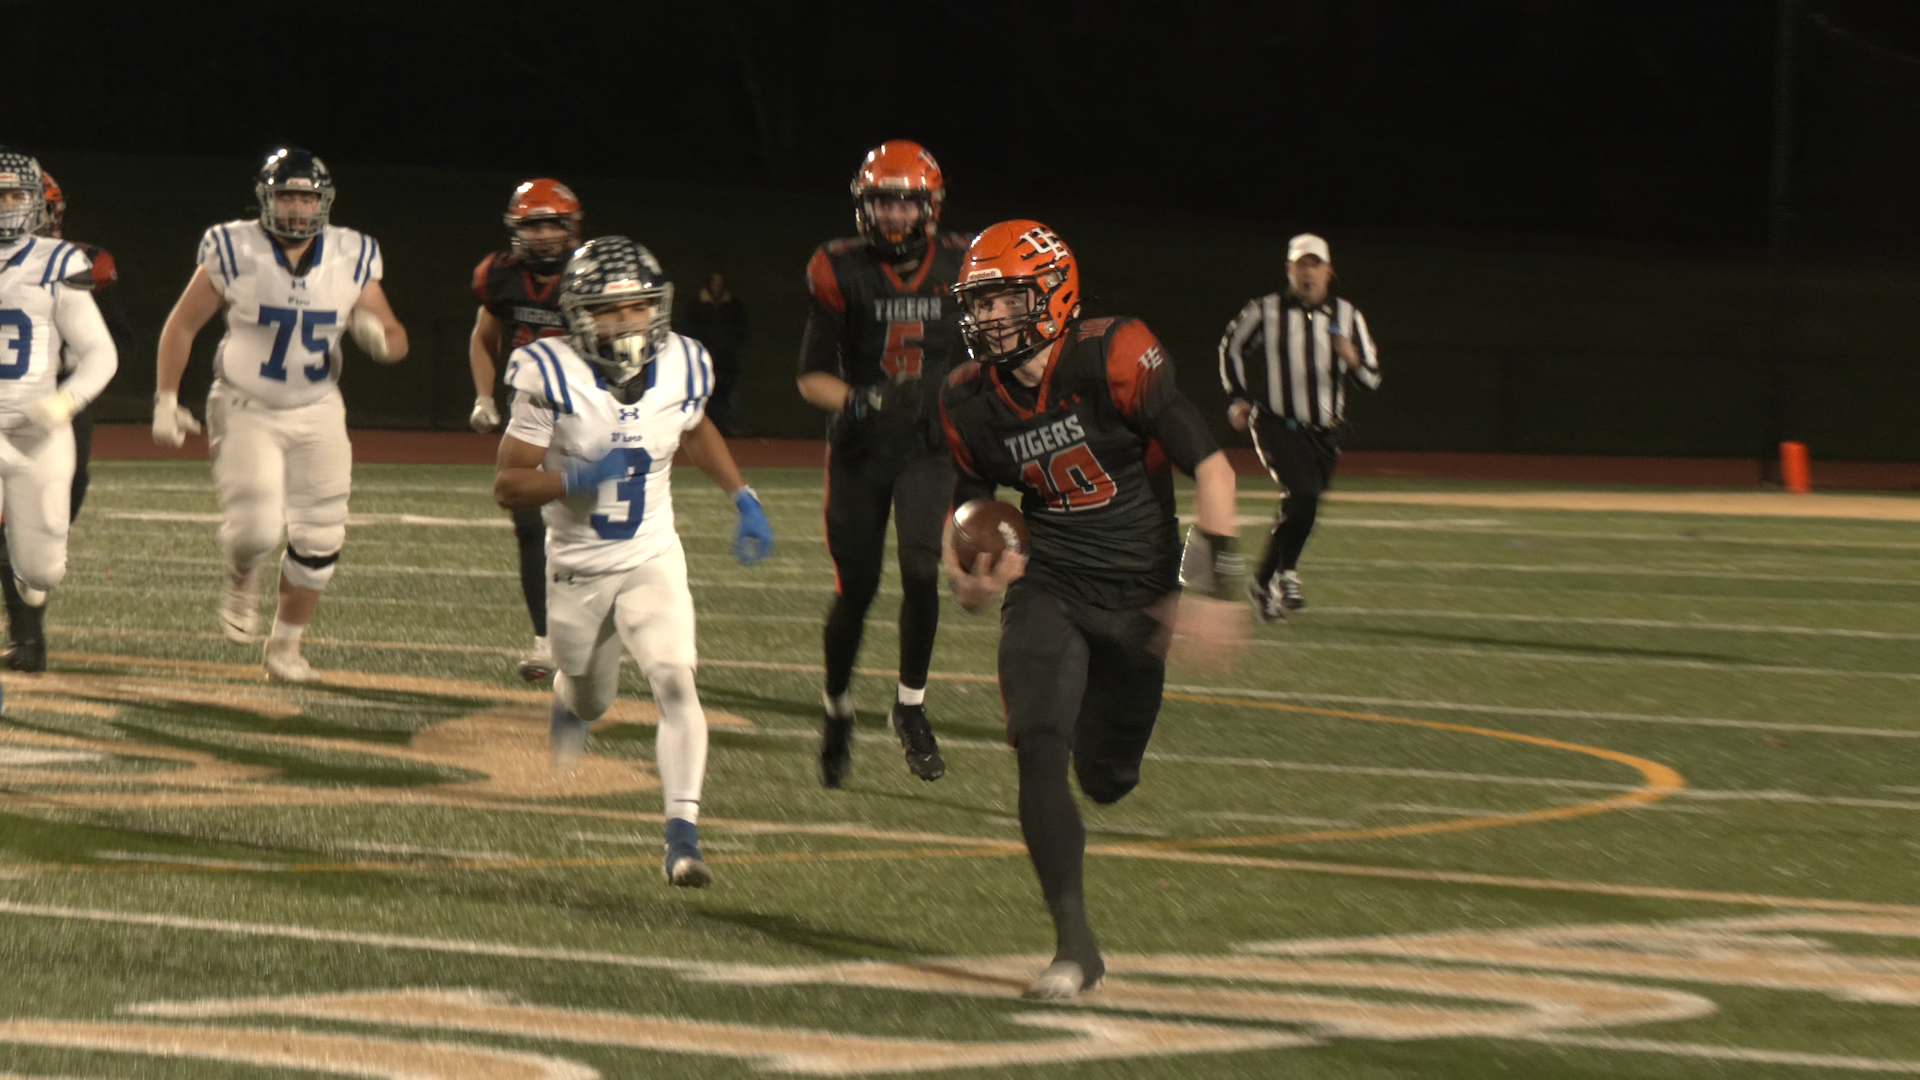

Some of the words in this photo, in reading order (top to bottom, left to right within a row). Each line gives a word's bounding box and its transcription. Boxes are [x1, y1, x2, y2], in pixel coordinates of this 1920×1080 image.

[258, 304, 338, 384] 75
[874, 297, 942, 322] TIGERS
[1003, 414, 1086, 464] TIGERS
[589, 446, 653, 541] 3
[1020, 441, 1118, 512] 10
